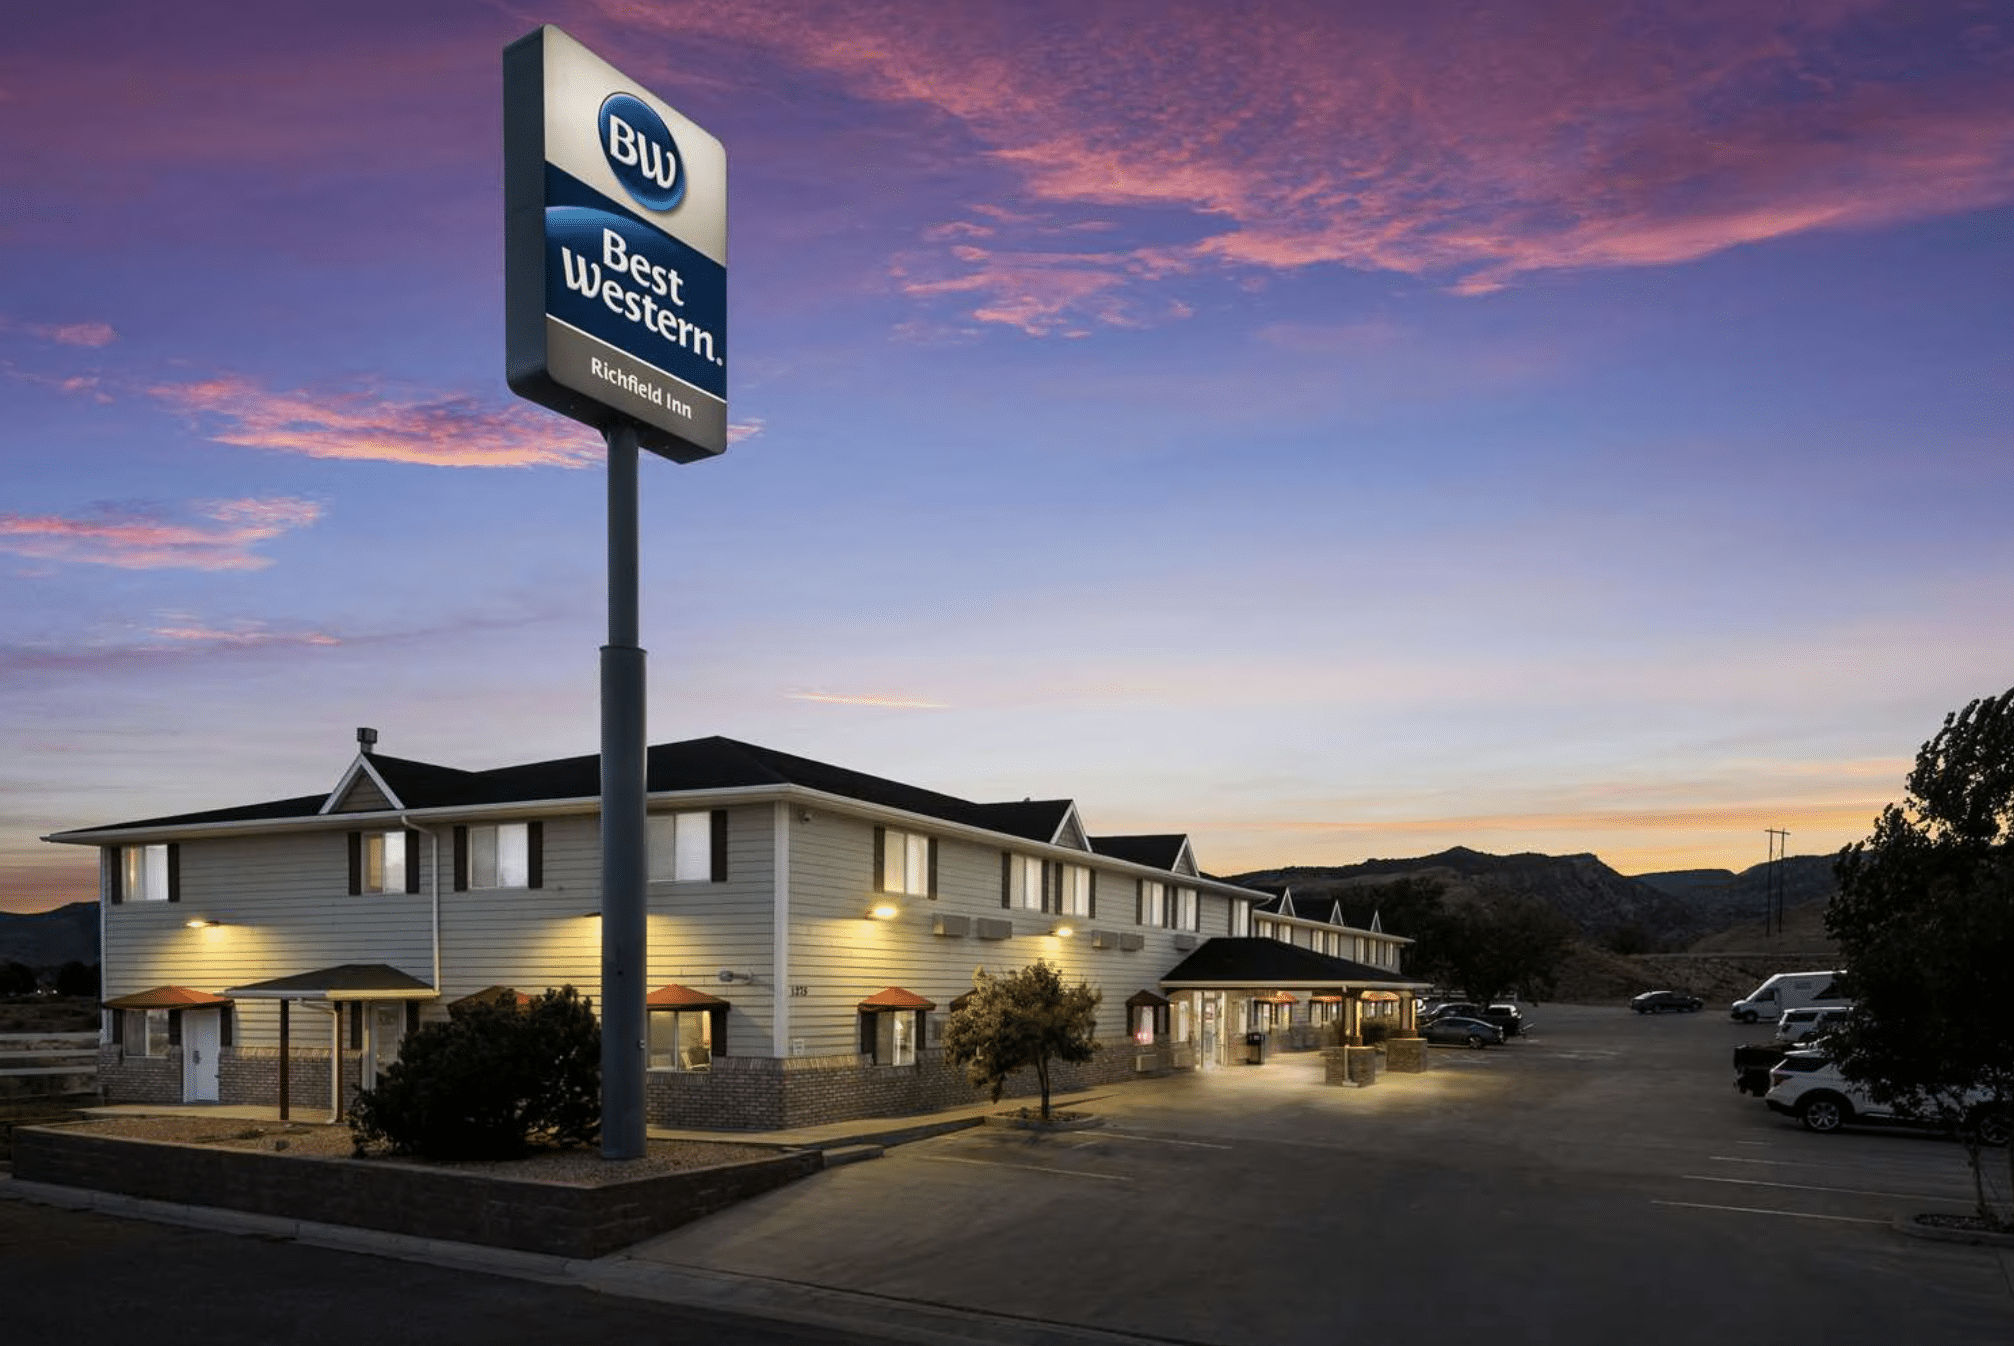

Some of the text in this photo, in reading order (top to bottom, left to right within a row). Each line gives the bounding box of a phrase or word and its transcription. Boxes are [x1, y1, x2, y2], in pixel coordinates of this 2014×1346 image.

[610, 114, 676, 189] BW
[603, 228, 684, 306] Best
[591, 357, 692, 419] Richfield Inn
